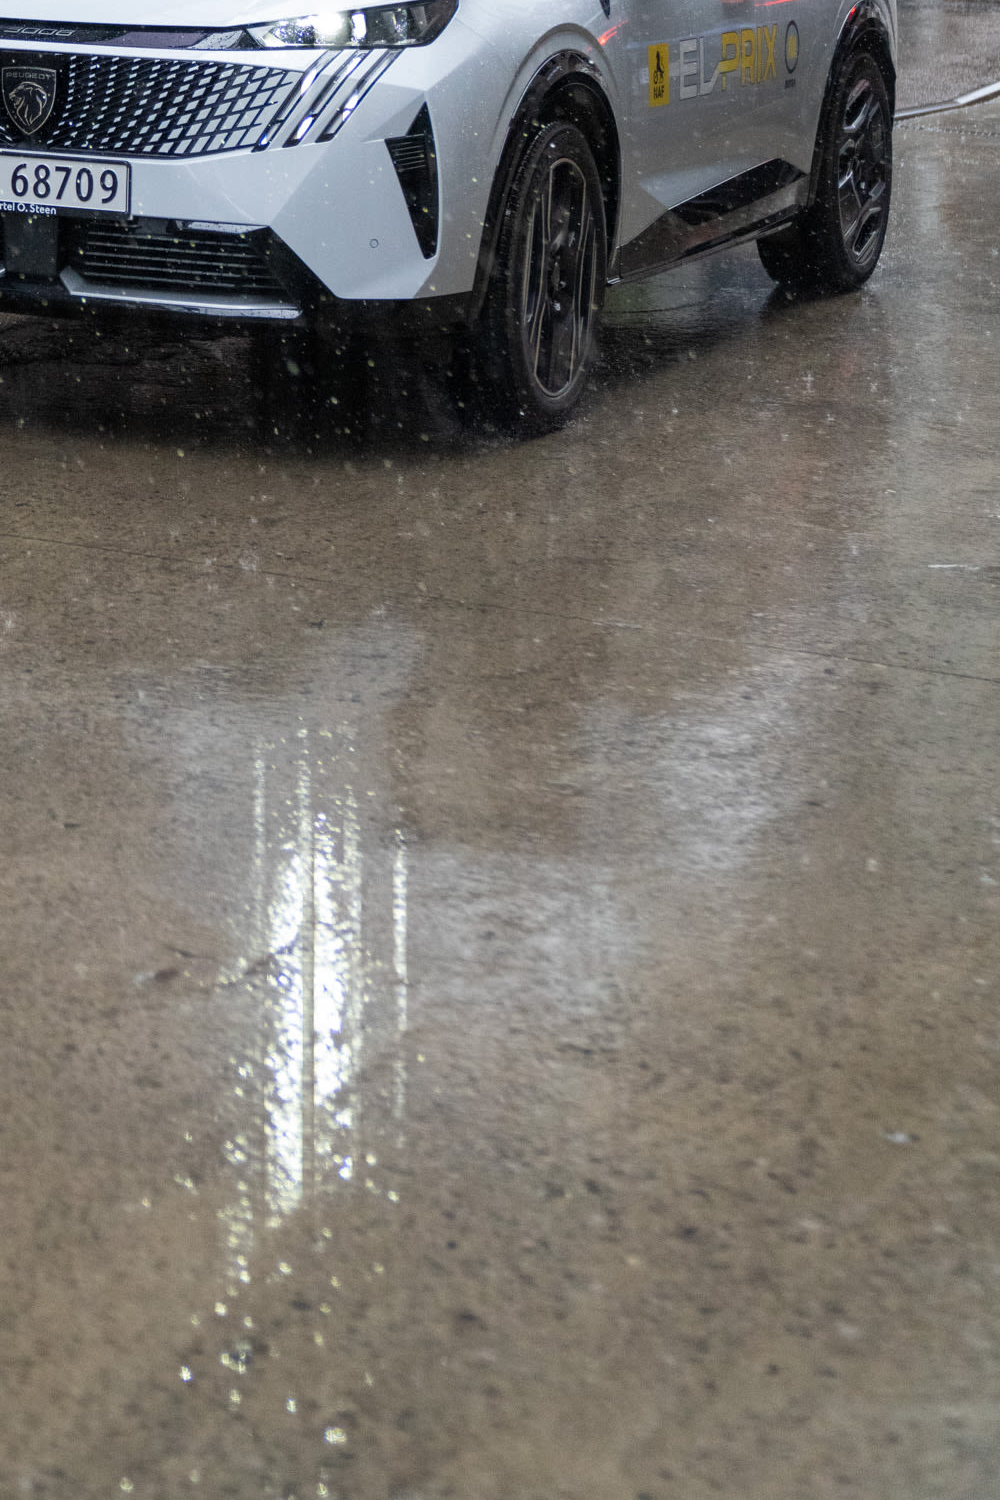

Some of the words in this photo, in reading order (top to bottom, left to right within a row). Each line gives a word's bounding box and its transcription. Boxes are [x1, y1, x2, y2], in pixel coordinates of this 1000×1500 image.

[6, 71, 52, 81] PEUGEOT
[653, 85, 665, 99] NAF
[10, 162, 119, 205] 68709
[17, 203, 28, 213] O.
[29, 204, 57, 215] Steen
